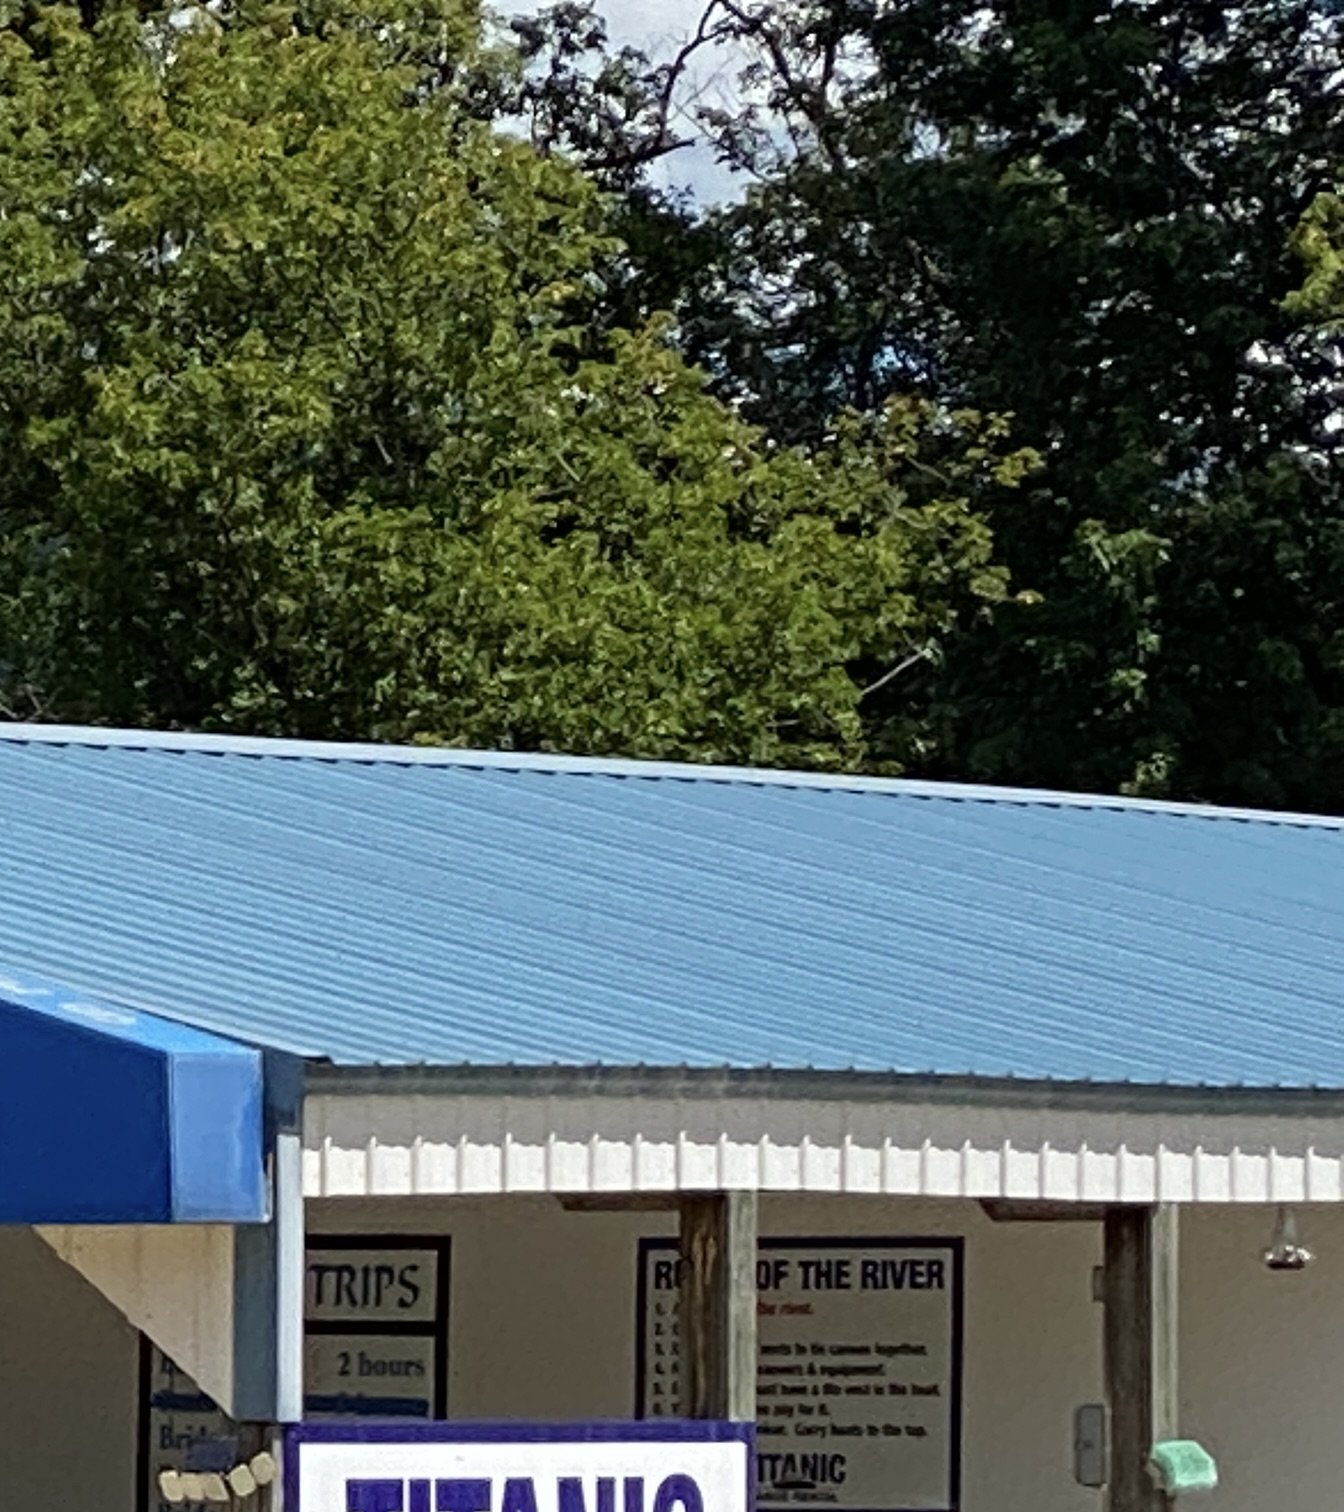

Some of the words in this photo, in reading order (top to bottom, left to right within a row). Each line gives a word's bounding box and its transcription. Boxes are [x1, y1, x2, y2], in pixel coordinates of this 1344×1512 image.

[307, 1264, 420, 1308] TRIPS
[756, 1260, 789, 1290] OF
[798, 1260, 851, 1290] THE
[861, 1260, 944, 1290] RIVER
[337, 1351, 350, 1376] 2
[358, 1350, 424, 1377] hours
[757, 1453, 847, 1483] ITANIC
